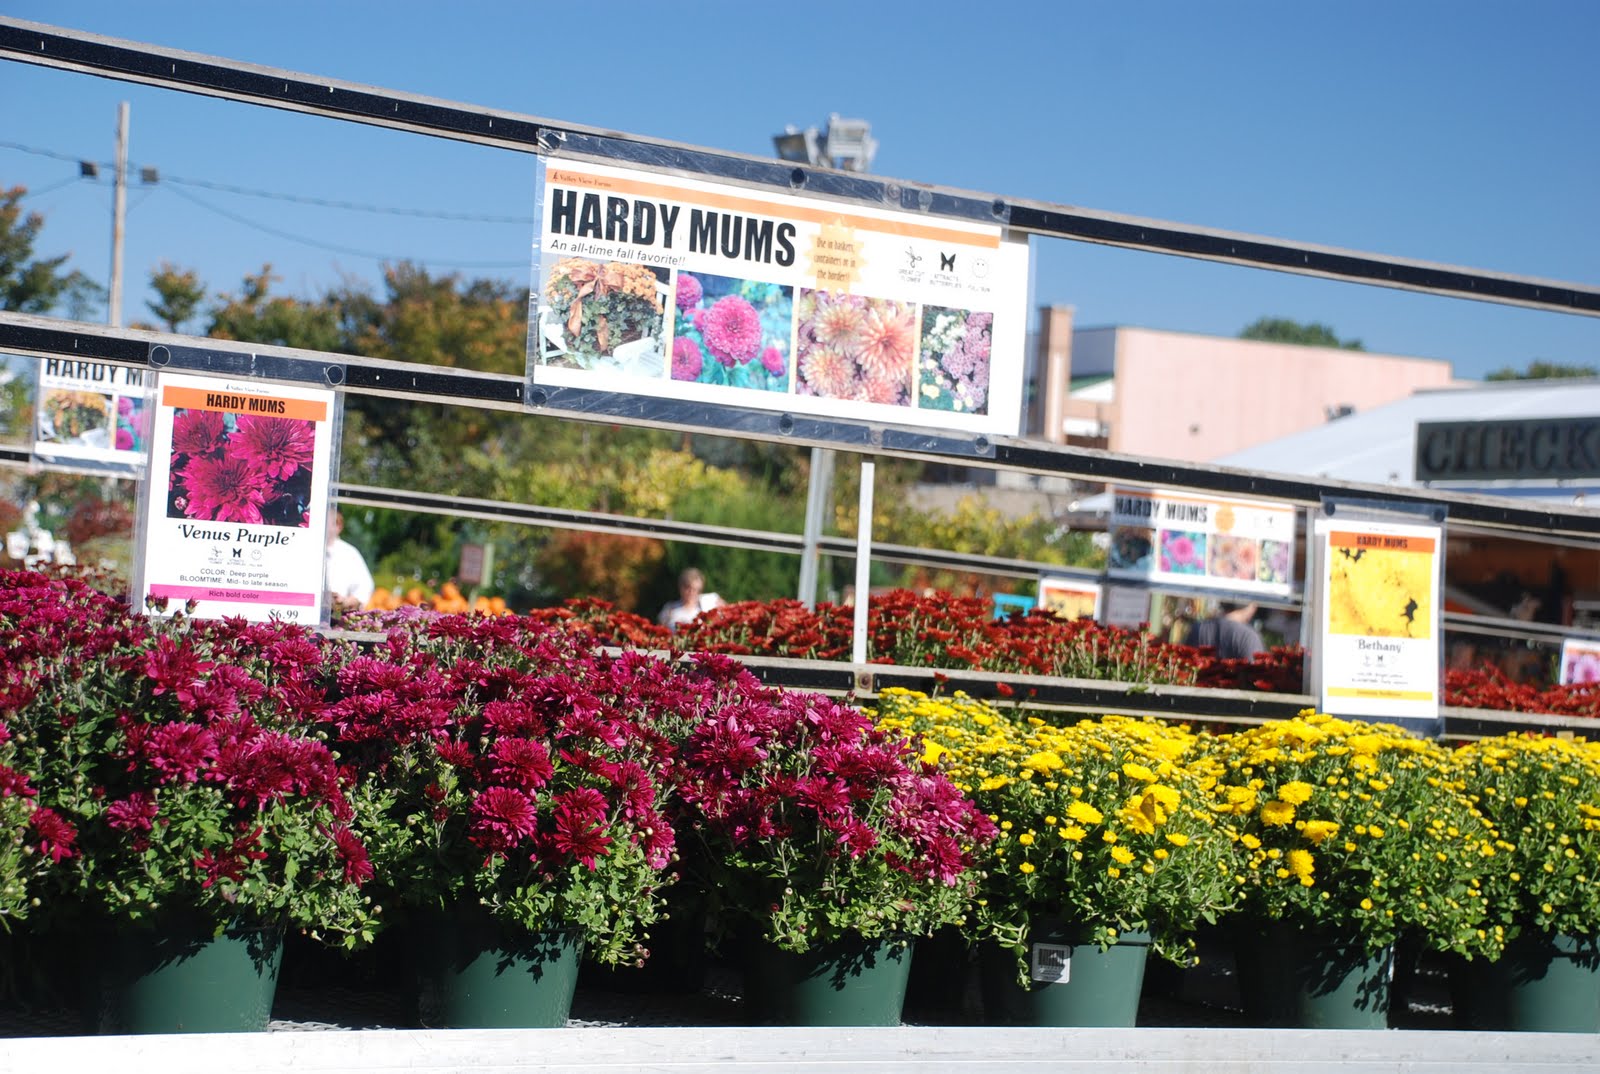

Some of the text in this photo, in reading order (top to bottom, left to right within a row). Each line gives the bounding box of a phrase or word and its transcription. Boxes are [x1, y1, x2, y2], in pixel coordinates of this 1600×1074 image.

[551, 188, 796, 267] HARDY MUMS
[550, 239, 567, 251] An
[570, 242, 613, 257] all-time
[616, 247, 634, 259] fall
[46, 357, 117, 383] HARDY
[206, 393, 286, 414] HARDY MUMS
[1115, 497, 1161, 517] HARDY
[1165, 502, 1208, 523] MUMS
[1356, 535, 1408, 549] HARDY MUMS
[200, 568, 226, 576] COLOR:
[229, 570, 247, 578] Deep
[250, 579, 263, 587] late
[208, 590, 225, 598] Rich
[269, 608, 299, 620] $6.99
